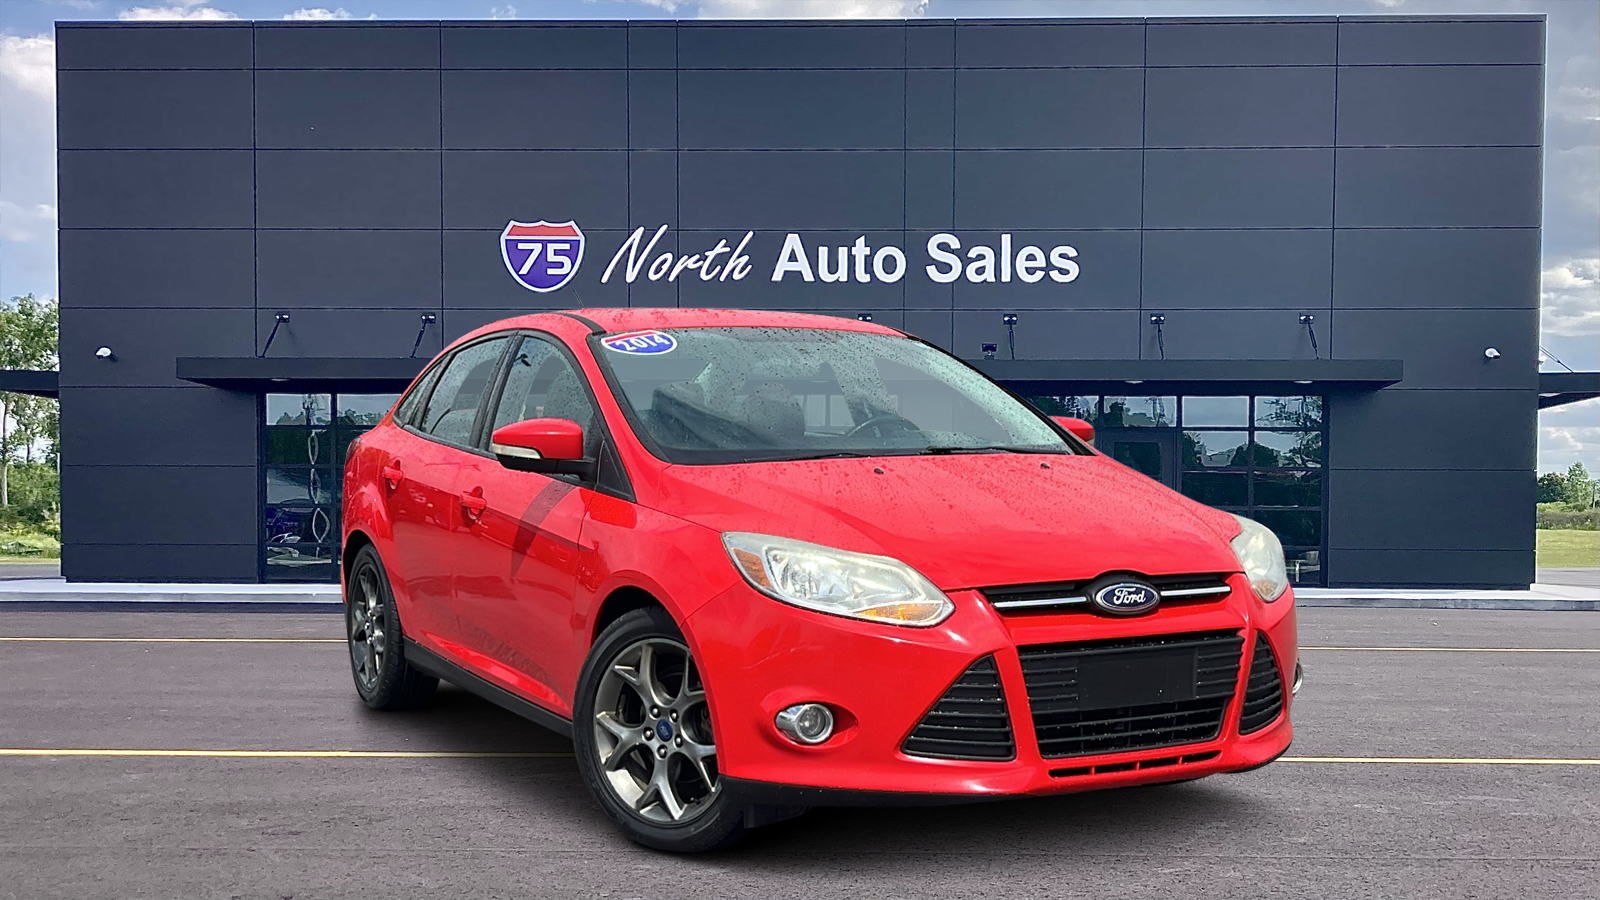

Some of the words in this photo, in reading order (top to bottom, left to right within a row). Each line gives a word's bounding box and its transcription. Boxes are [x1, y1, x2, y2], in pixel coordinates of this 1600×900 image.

[517, 243, 572, 275] 75
[601, 224, 754, 284] North
[770, 233, 907, 283] Auto
[925, 233, 1080, 283] Sales
[615, 334, 670, 351] 2014
[1113, 587, 1147, 605] Ford
